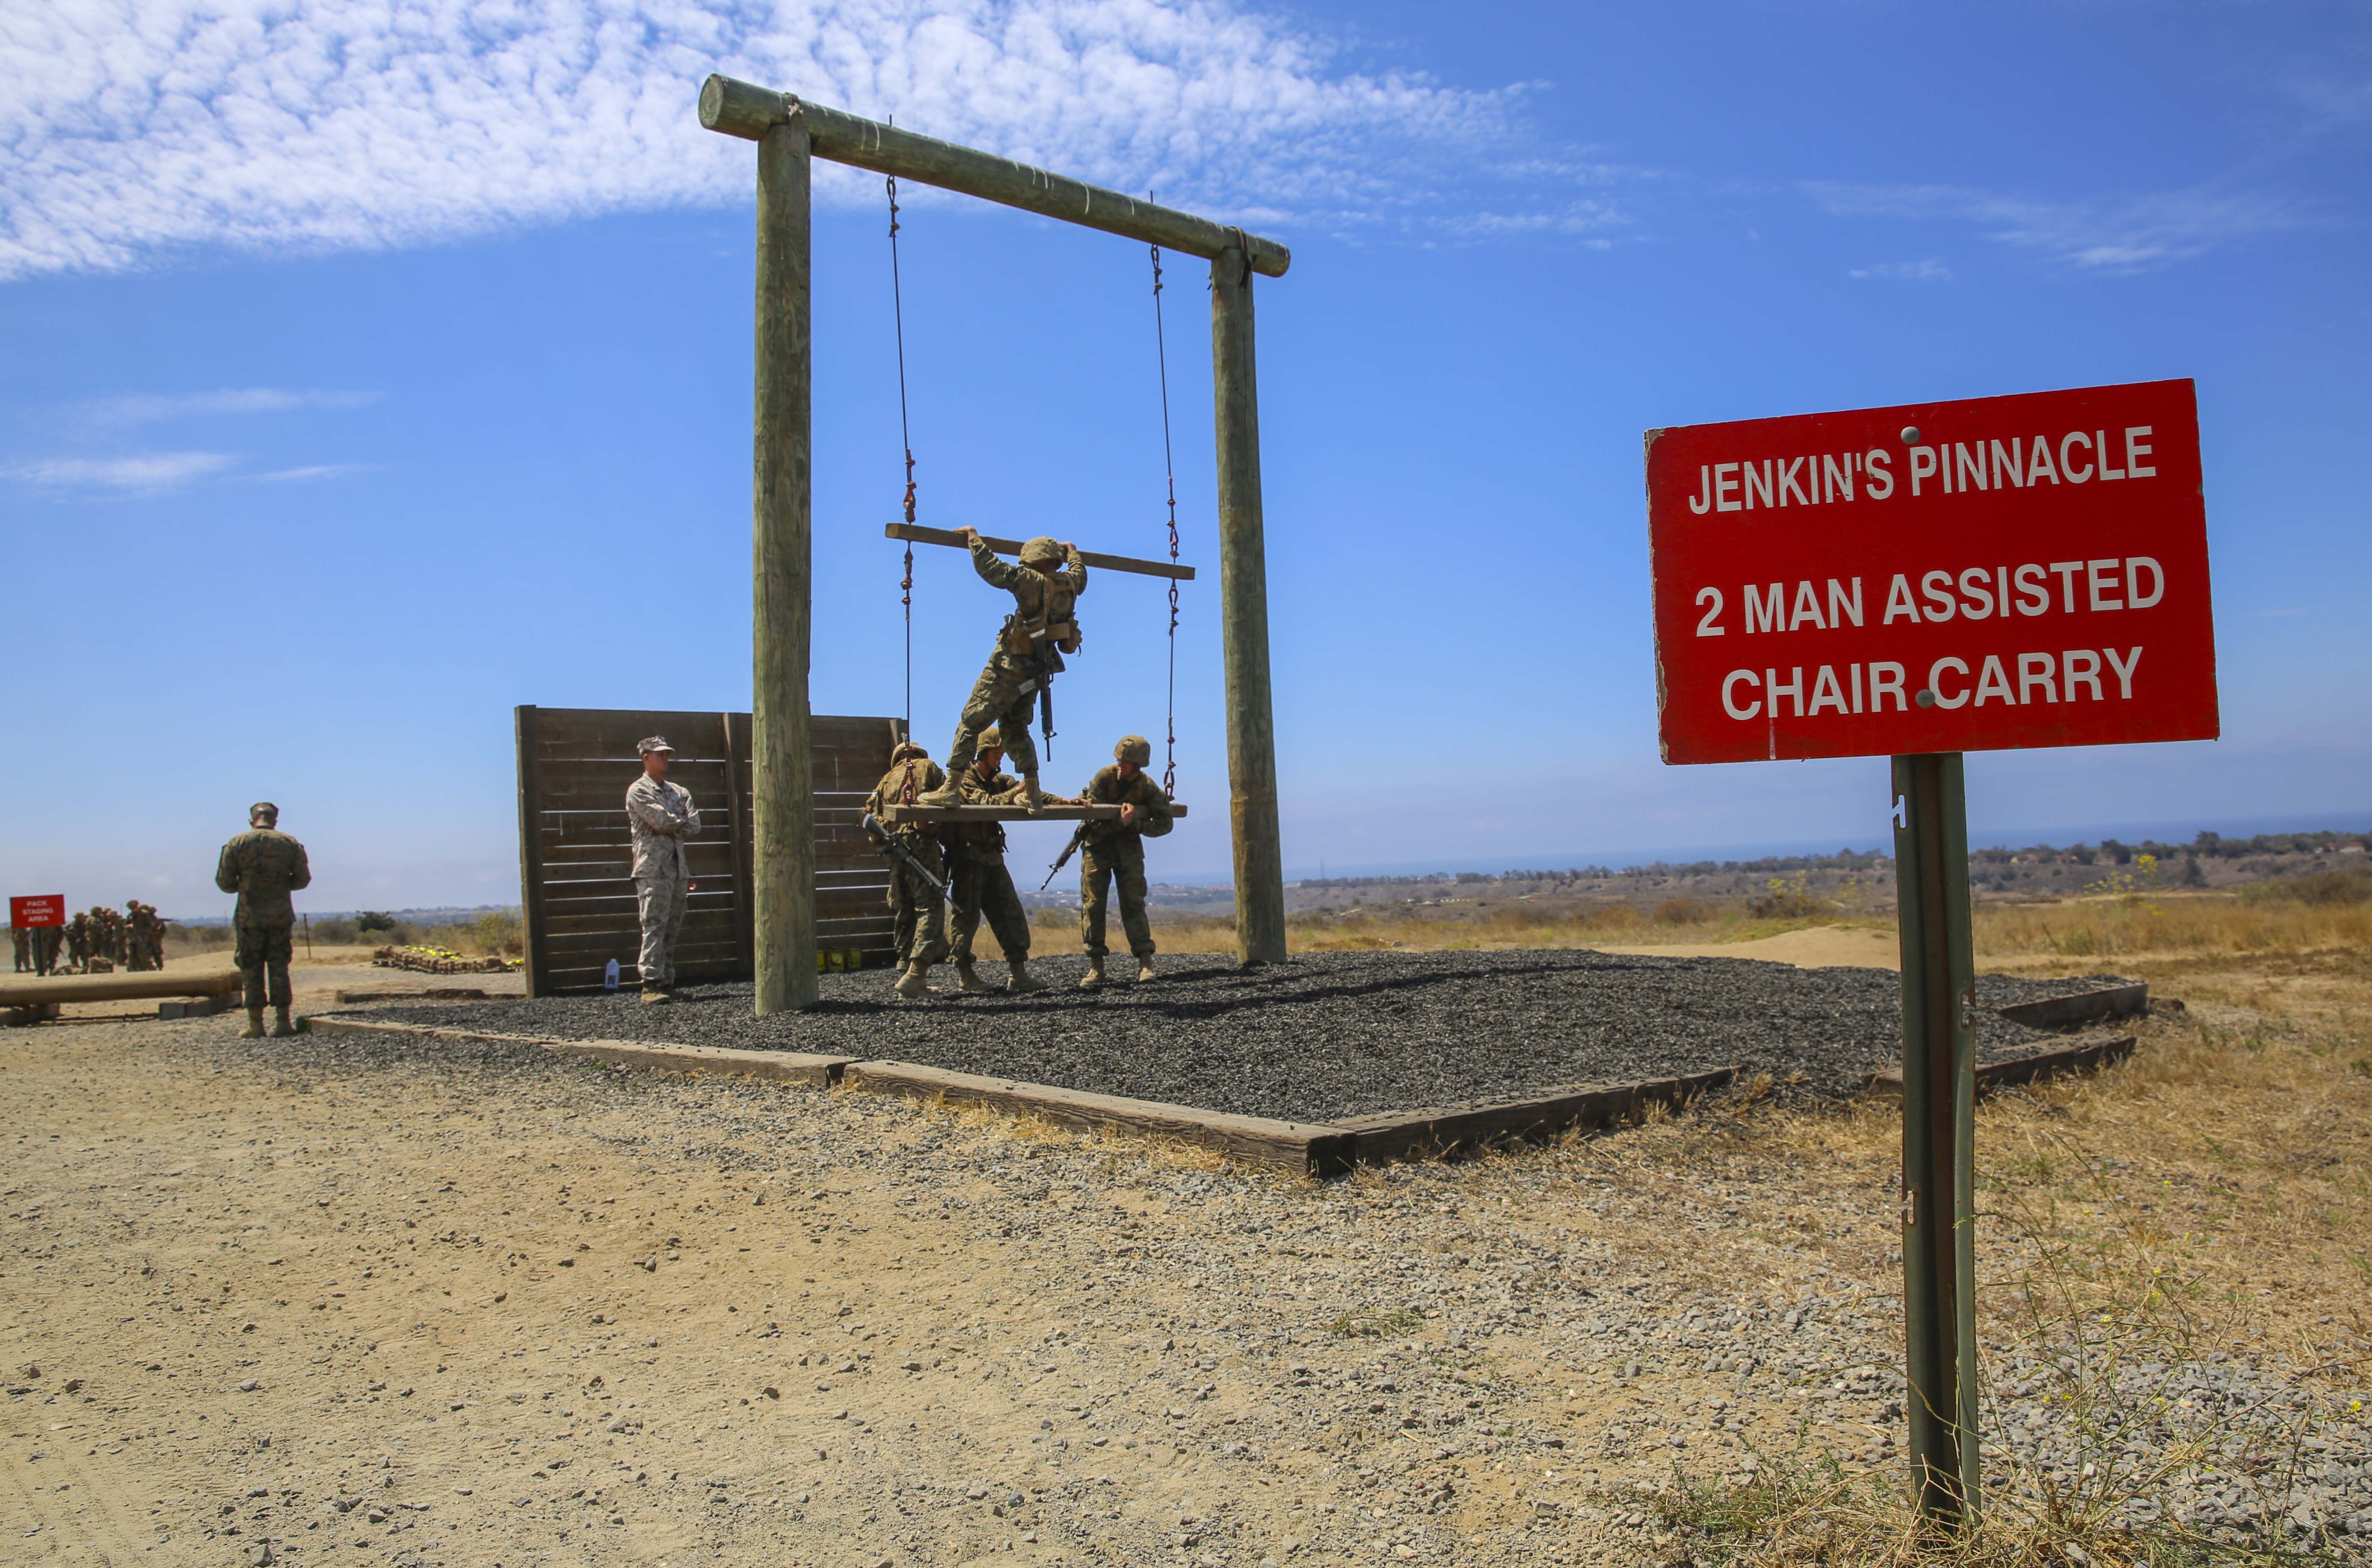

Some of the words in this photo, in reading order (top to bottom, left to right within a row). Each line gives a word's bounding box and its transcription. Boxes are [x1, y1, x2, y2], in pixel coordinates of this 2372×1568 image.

[1689, 449, 1894, 515] JENKIN'S
[1910, 426, 2156, 496] PINNACLE
[1695, 586, 1725, 637] 2
[1744, 577, 1864, 634] MAN
[1883, 556, 2165, 625] ASSISTED
[1722, 661, 1908, 720] CHAIR
[1928, 646, 2144, 710] CARRY
